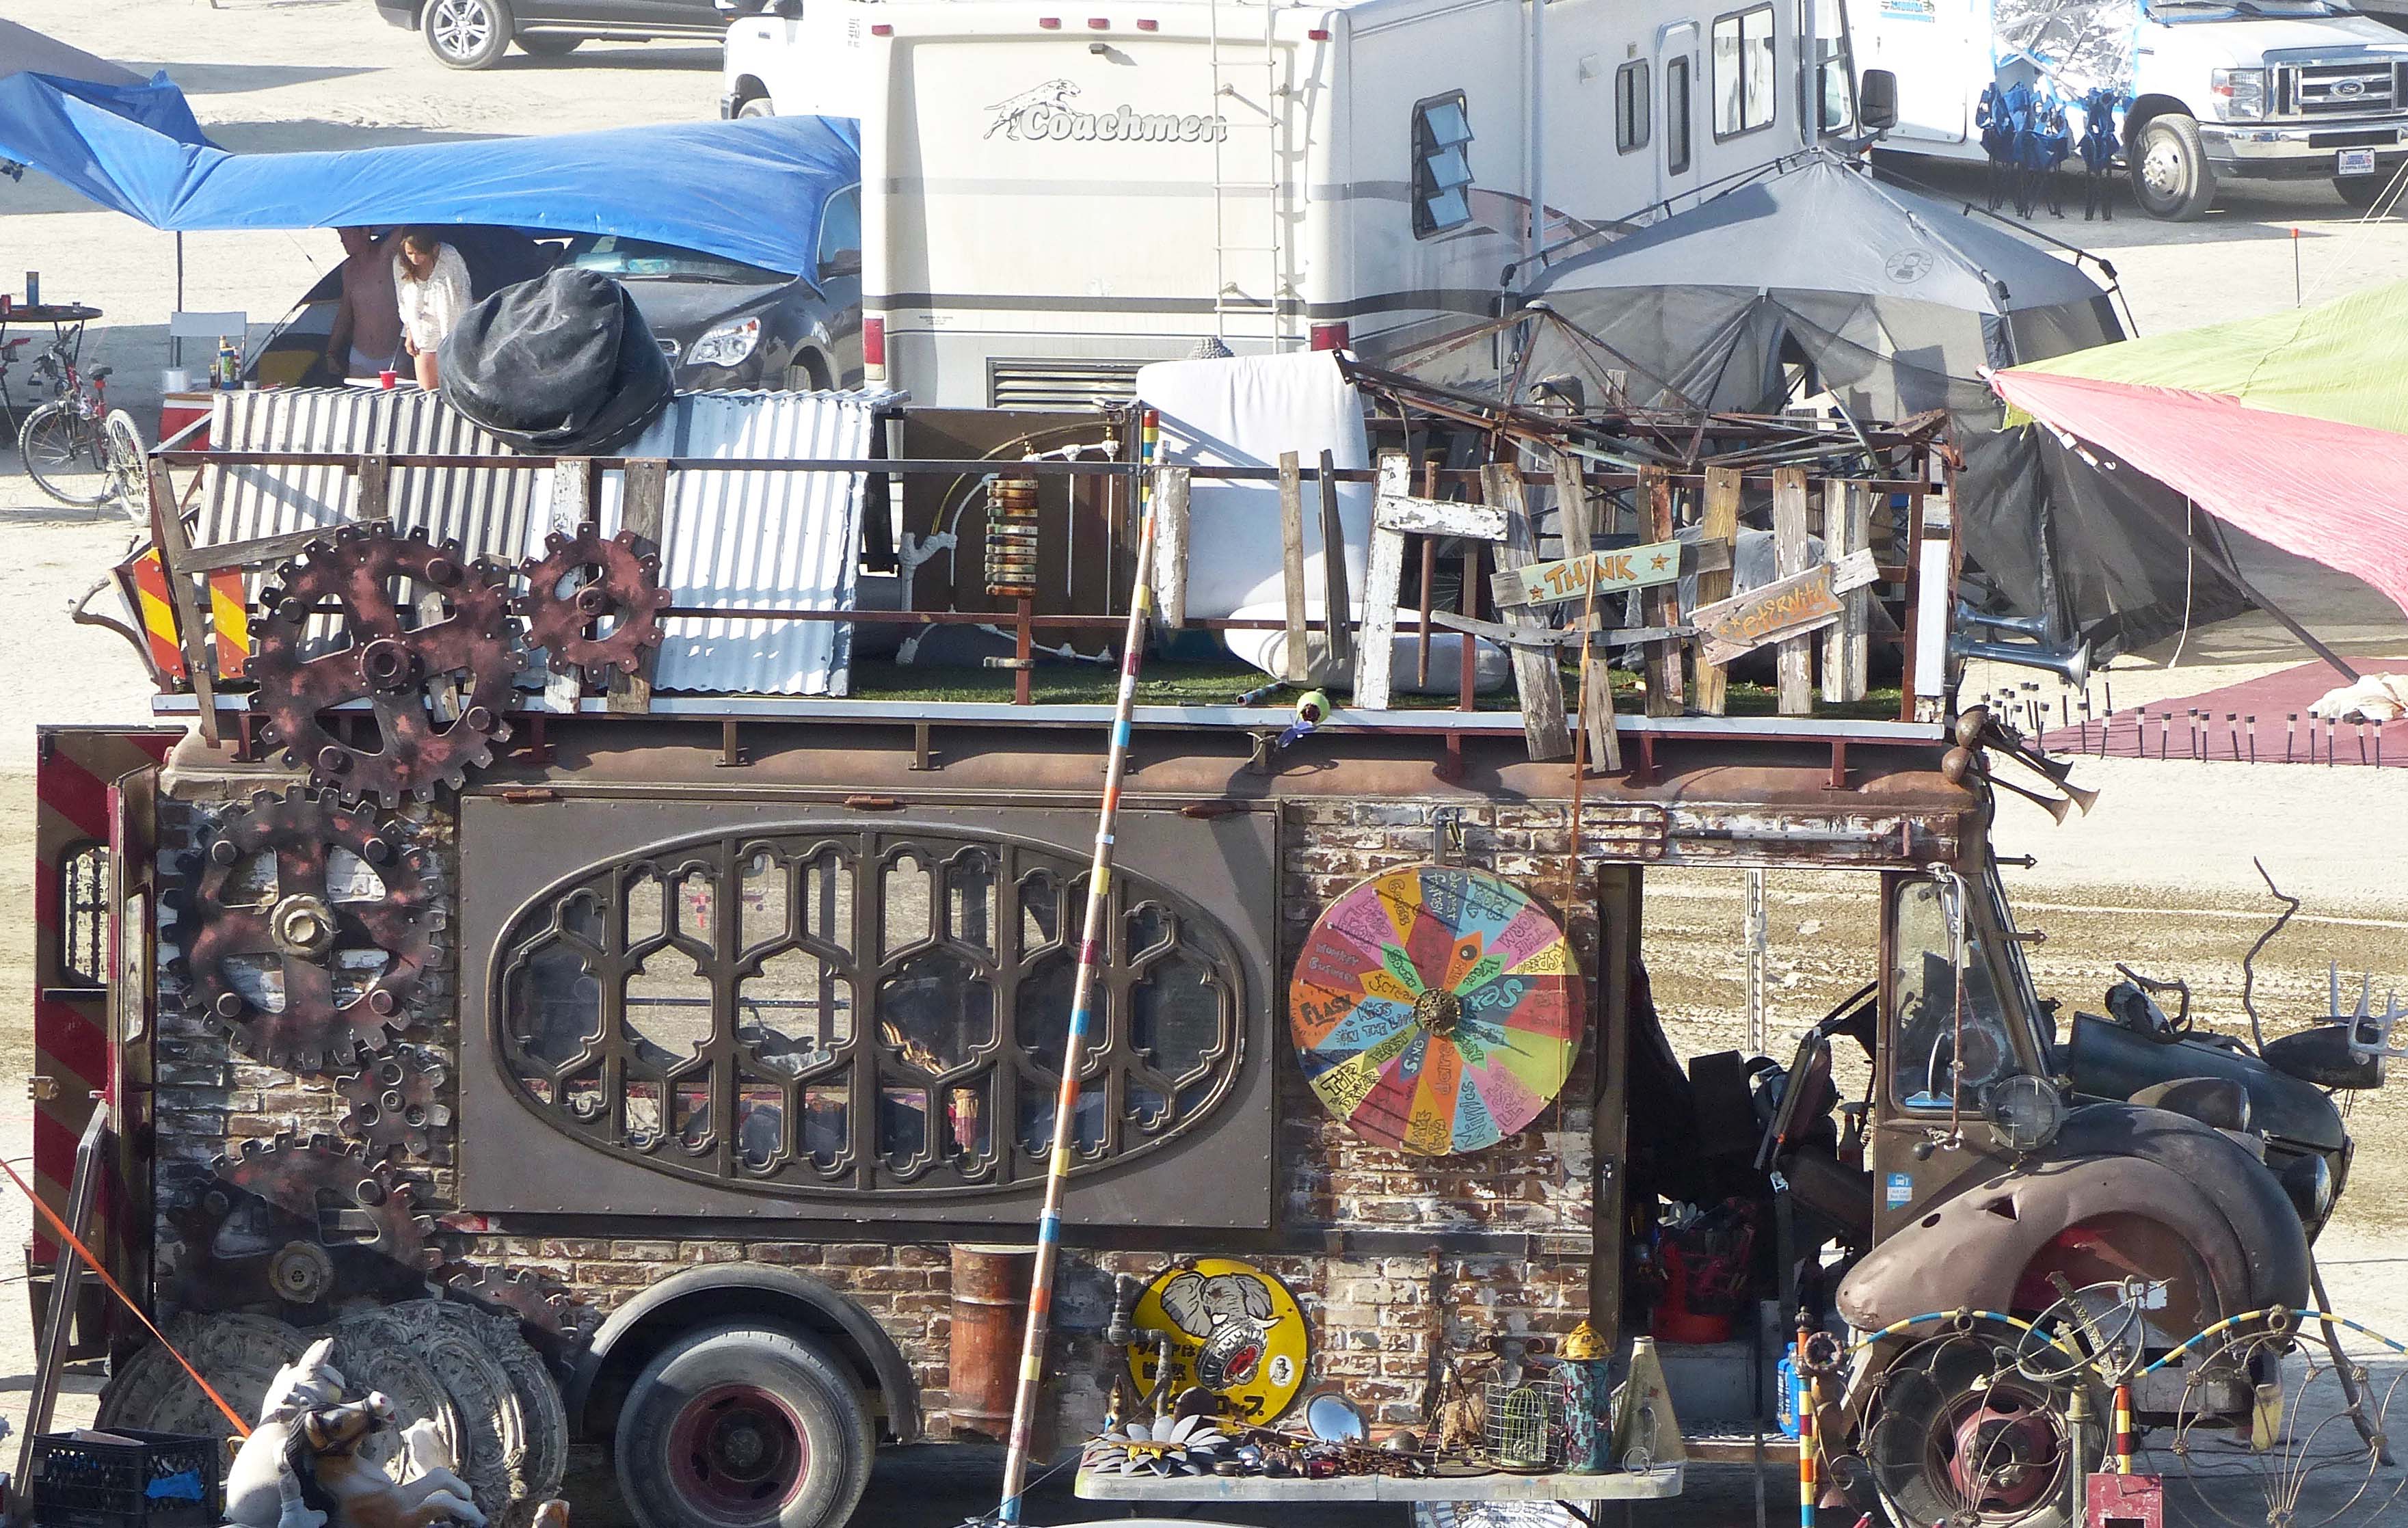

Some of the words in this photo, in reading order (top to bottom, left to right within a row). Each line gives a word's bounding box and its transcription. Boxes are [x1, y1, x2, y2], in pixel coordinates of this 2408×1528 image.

[1020, 104, 1227, 142] Coachmen
[1544, 555, 1638, 595] THNK
[1362, 1023, 1388, 1036] THE
